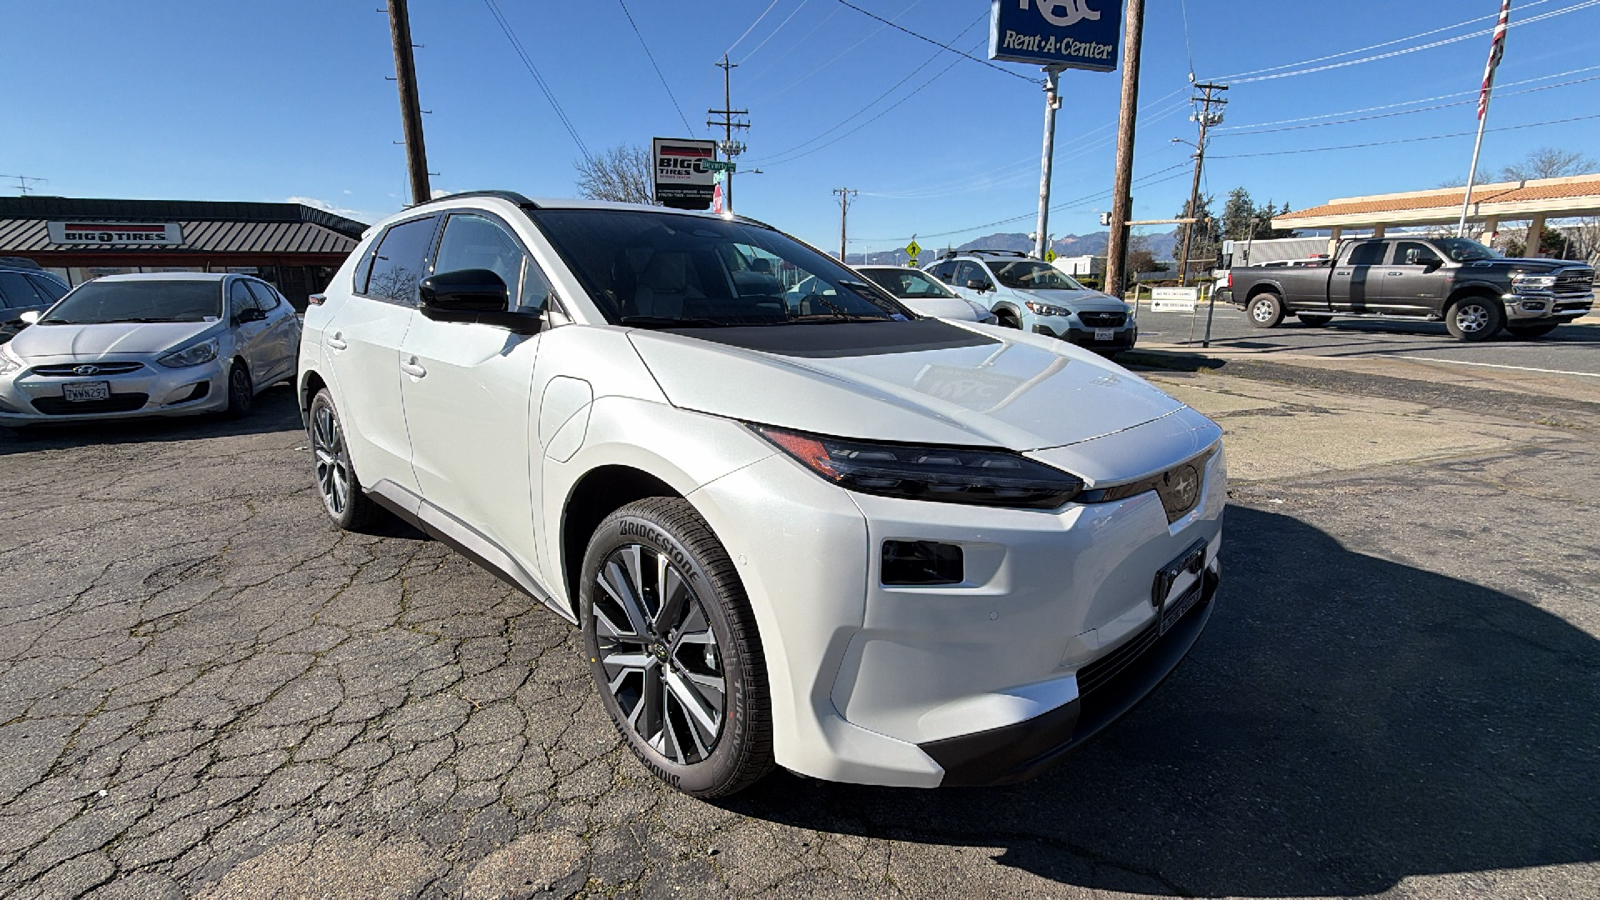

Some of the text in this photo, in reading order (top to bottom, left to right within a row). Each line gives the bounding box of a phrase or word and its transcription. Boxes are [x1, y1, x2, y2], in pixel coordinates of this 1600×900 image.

[659, 158, 692, 168] BIG
[702, 161, 728, 170] Beverly
[65, 232, 96, 240] BIG
[115, 233, 166, 241] TIRES
[619, 519, 701, 582] BRIDGESTONE
